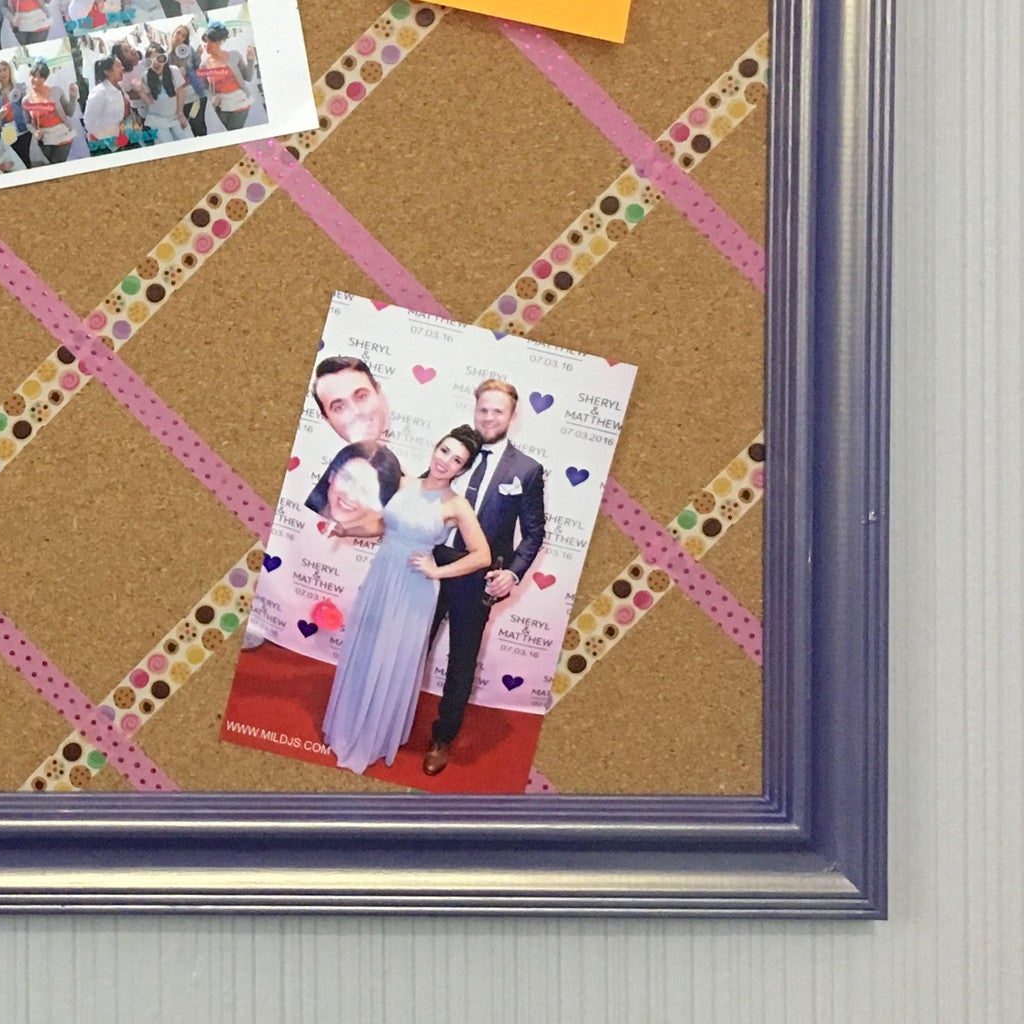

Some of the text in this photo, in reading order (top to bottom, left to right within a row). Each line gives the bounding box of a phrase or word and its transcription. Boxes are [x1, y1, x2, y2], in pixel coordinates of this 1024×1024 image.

[410, 326, 454, 343] 07.03.16
[348, 336, 392, 356] SHERYL
[361, 350, 371, 360] &
[529, 354, 573, 372] 07.03.16
[578, 392, 622, 411] SHERYL
[564, 409, 623, 431] MATTHEW
[590, 406, 599, 416] &
[560, 426, 616, 447] 07.03.2016
[301, 557, 340, 576] SHERYL
[313, 570, 321, 579] &
[292, 571, 344, 594] MATTHEW
[510, 614, 550, 631] SHERYL
[522, 627, 530, 636] &
[498, 628, 553, 648] MATTHEW
[500, 643, 539, 659] 07.03.16
